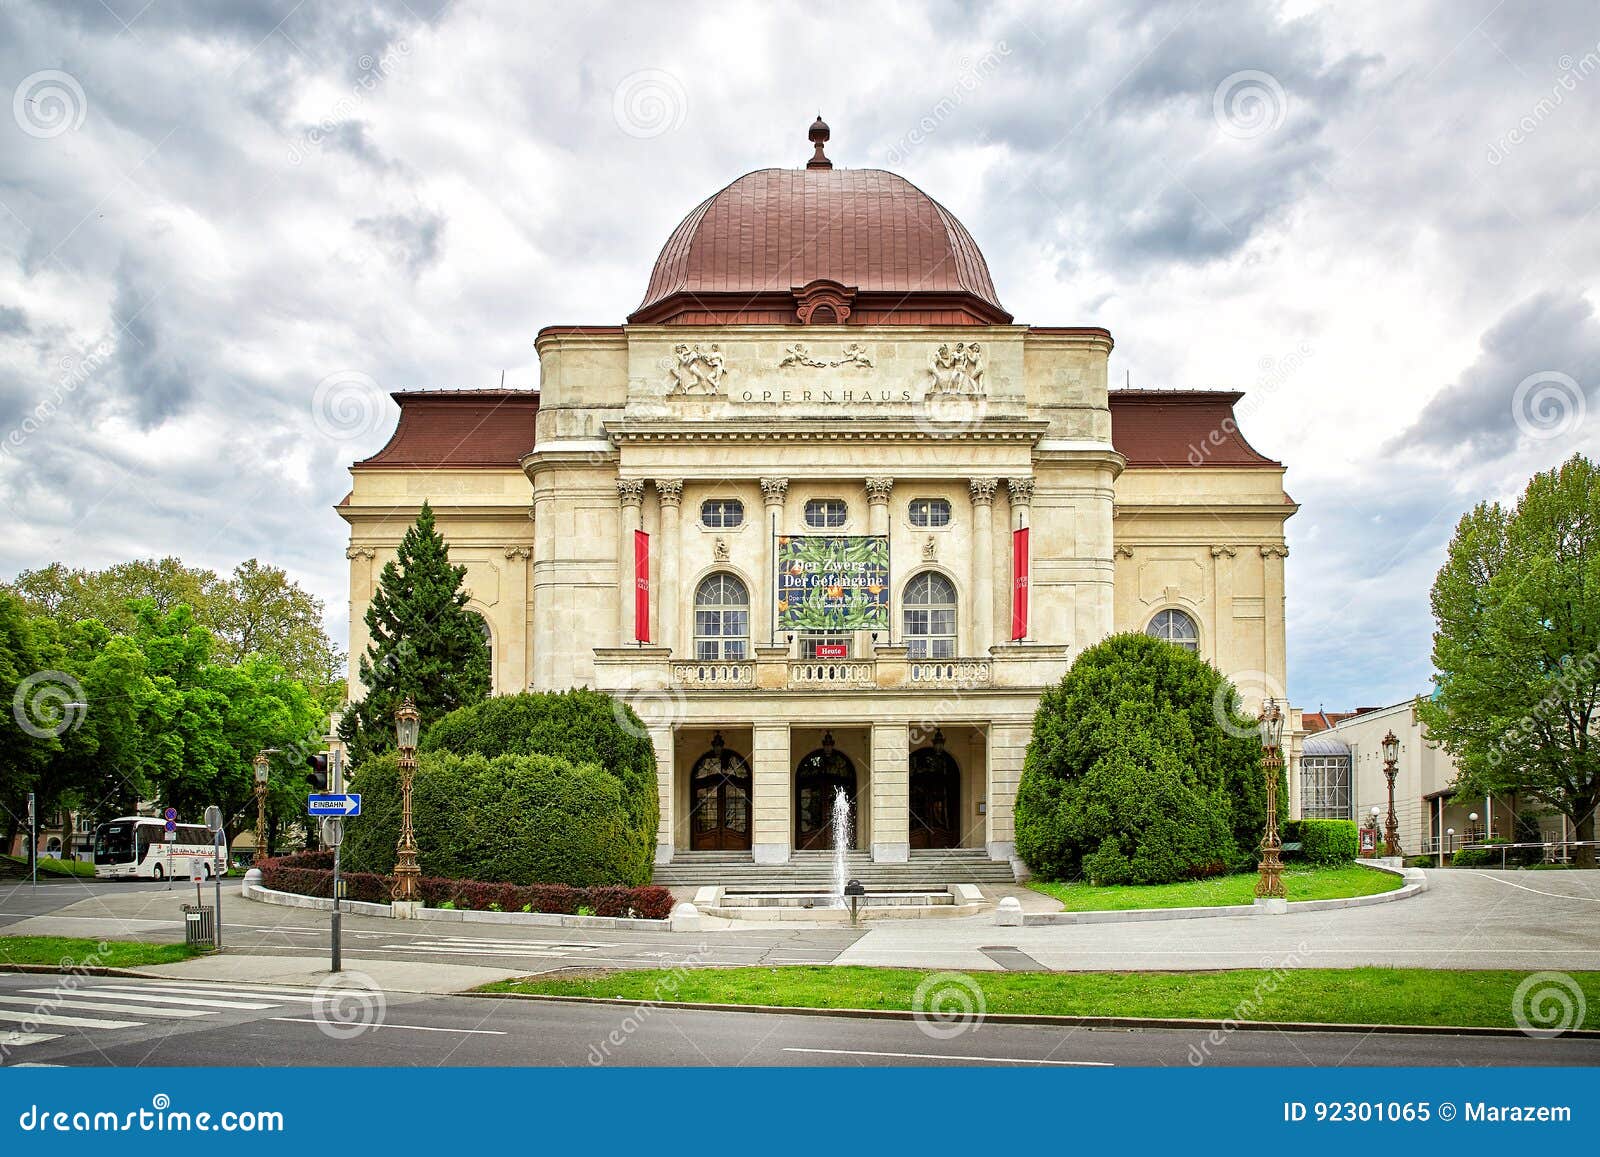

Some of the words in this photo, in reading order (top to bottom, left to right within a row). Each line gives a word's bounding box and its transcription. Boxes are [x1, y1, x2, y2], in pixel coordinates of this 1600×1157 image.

[742, 390, 912, 401] OPERNHAUS
[793, 559, 819, 571] Der
[823, 559, 866, 573] Zwerg
[783, 574, 808, 587] Der
[811, 574, 883, 588] Gefangene
